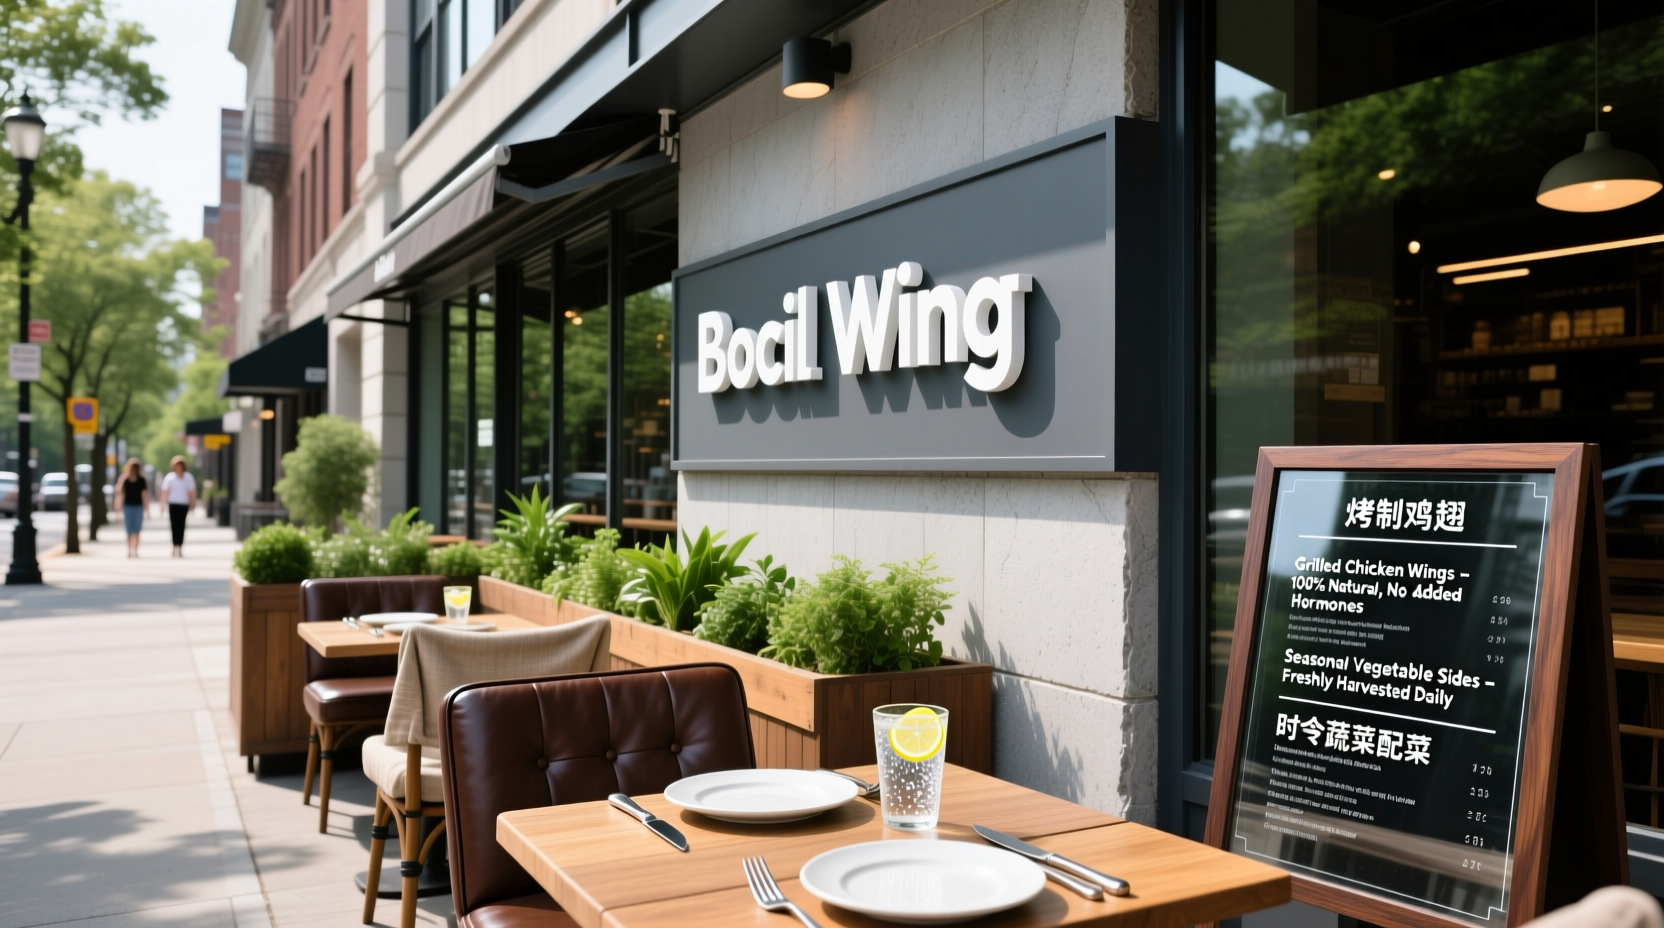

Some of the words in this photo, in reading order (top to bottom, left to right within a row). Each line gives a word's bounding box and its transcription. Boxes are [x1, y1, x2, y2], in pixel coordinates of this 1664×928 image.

[698, 285, 822, 393] Bocil
[826, 261, 1032, 392] Wing
[1345, 497, 1466, 532] 烤制鸡翅
[1295, 556, 1341, 574] Grilled
[1345, 560, 1404, 577] Chicken
[1408, 563, 1455, 584] Wings
[1291, 576, 1325, 592] 100%
[1328, 579, 1383, 599] Natural,
[1387, 582, 1407, 598] No
[1412, 584, 1462, 602] Added
[1291, 594, 1364, 614] Hormones
[1284, 648, 1349, 670] Seasonal
[1353, 657, 1434, 682] Vegetable
[1437, 667, 1480, 688] Sides
[1282, 668, 1334, 691] Freshly
[1336, 675, 1411, 700] Harvested
[1414, 686, 1454, 710] Daily
[1276, 713, 1432, 765] 时令蔬菜配菜
